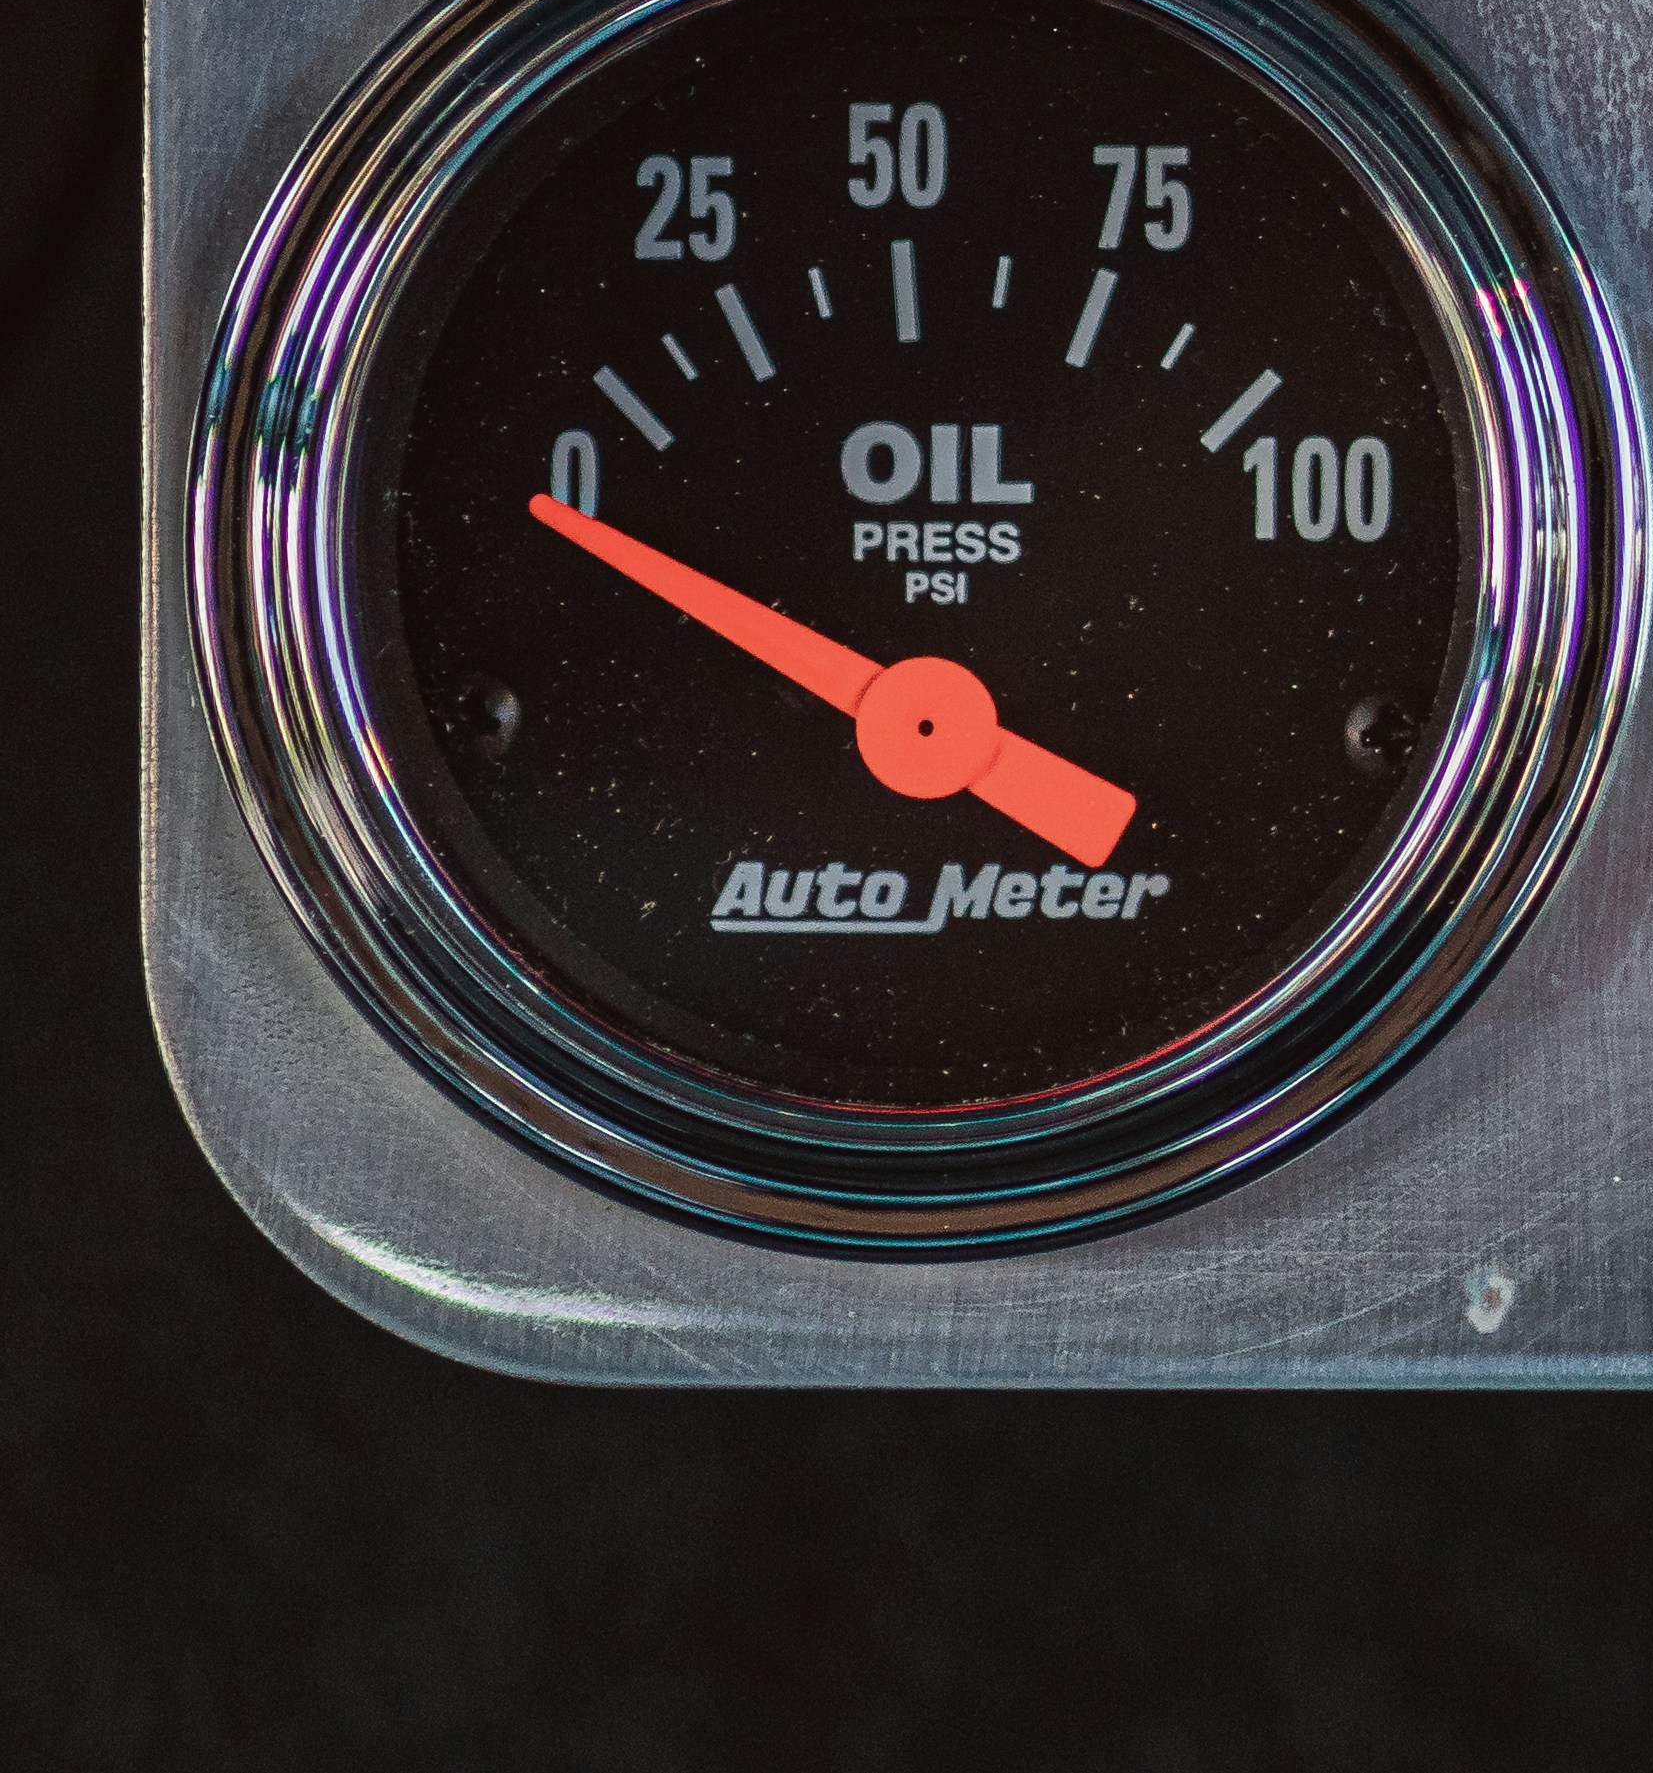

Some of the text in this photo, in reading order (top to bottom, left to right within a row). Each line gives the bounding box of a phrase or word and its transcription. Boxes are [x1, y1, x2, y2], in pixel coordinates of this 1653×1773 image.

[847, 102, 948, 210] 50
[1093, 145, 1191, 253] 75
[634, 153, 737, 262] 25
[551, 428, 600, 519] 0
[841, 421, 1034, 506] OIL
[1242, 433, 1392, 543] 100
[852, 521, 1020, 564] PRESS
[904, 571, 968, 604] PSI
[711, 863, 1169, 932] Auto Meter
